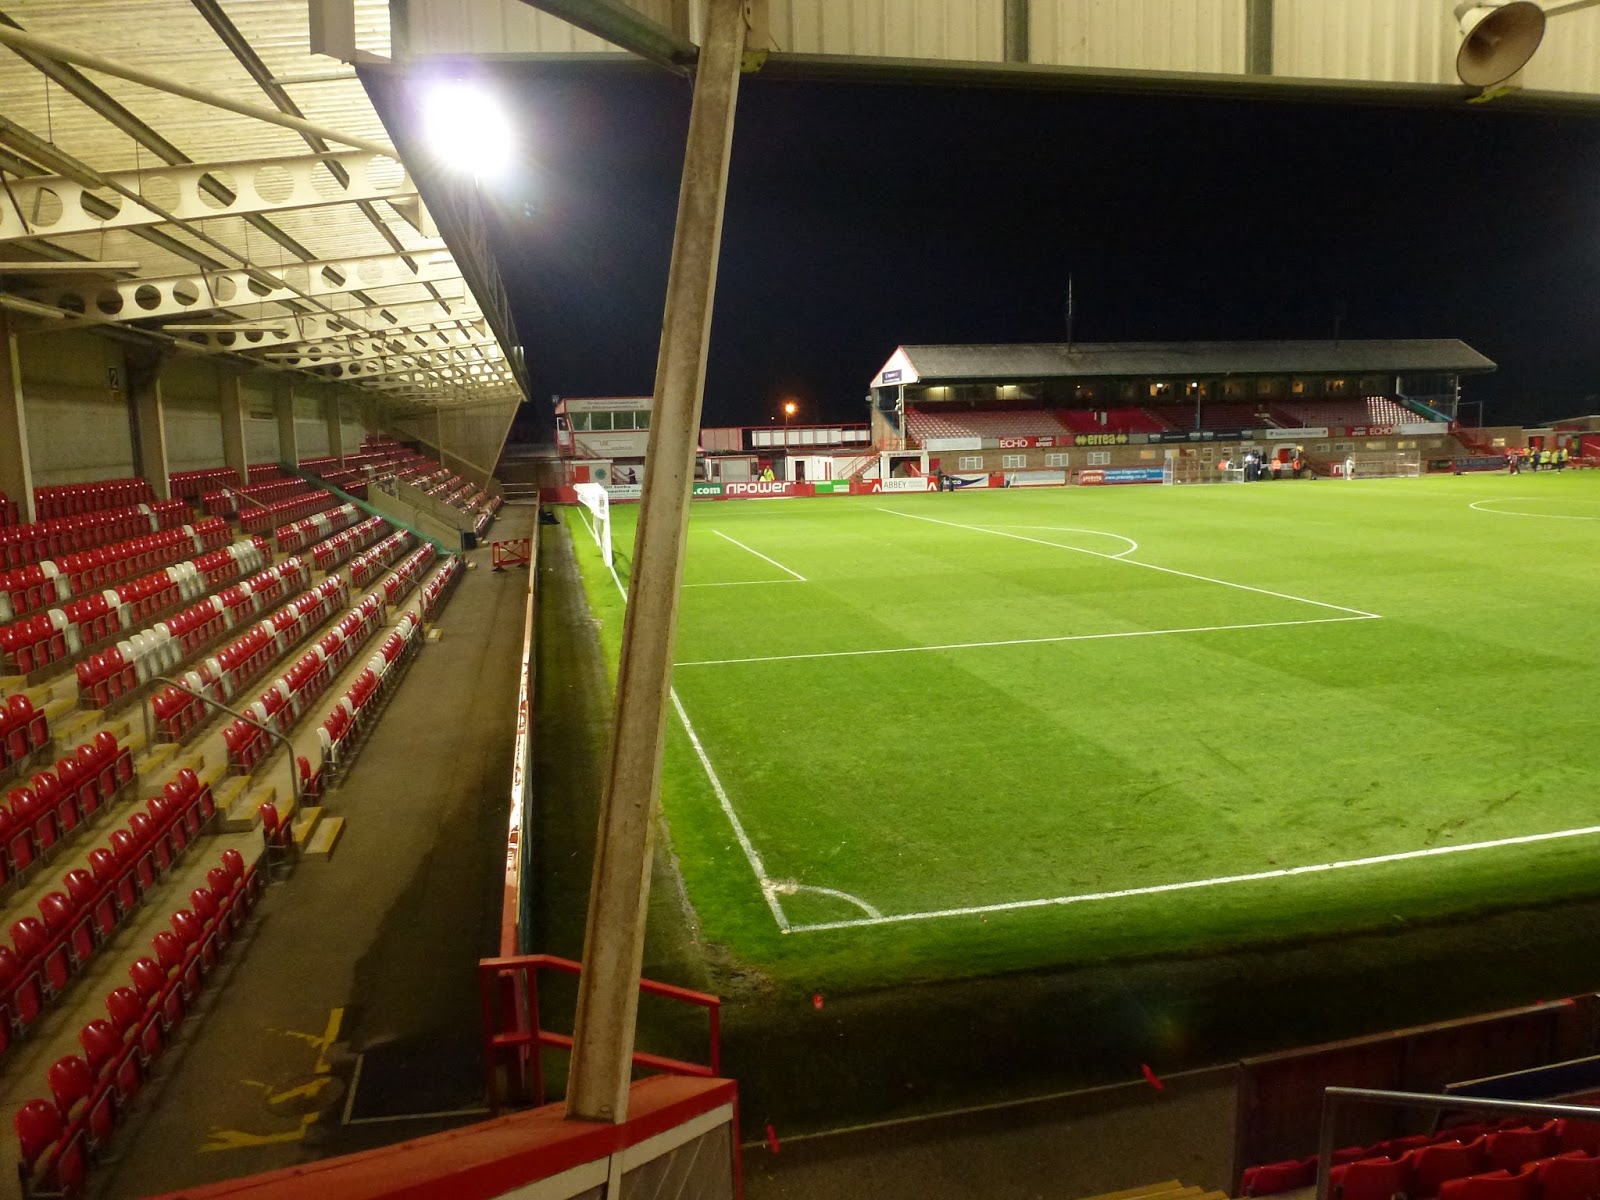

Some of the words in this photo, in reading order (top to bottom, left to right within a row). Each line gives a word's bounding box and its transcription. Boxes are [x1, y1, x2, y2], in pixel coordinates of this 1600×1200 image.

[1370, 427, 1393, 435] ECHO
[1000, 439, 1028, 448] ECHO
[884, 481, 907, 489] ABBEY
[693, 486, 721, 495] .com
